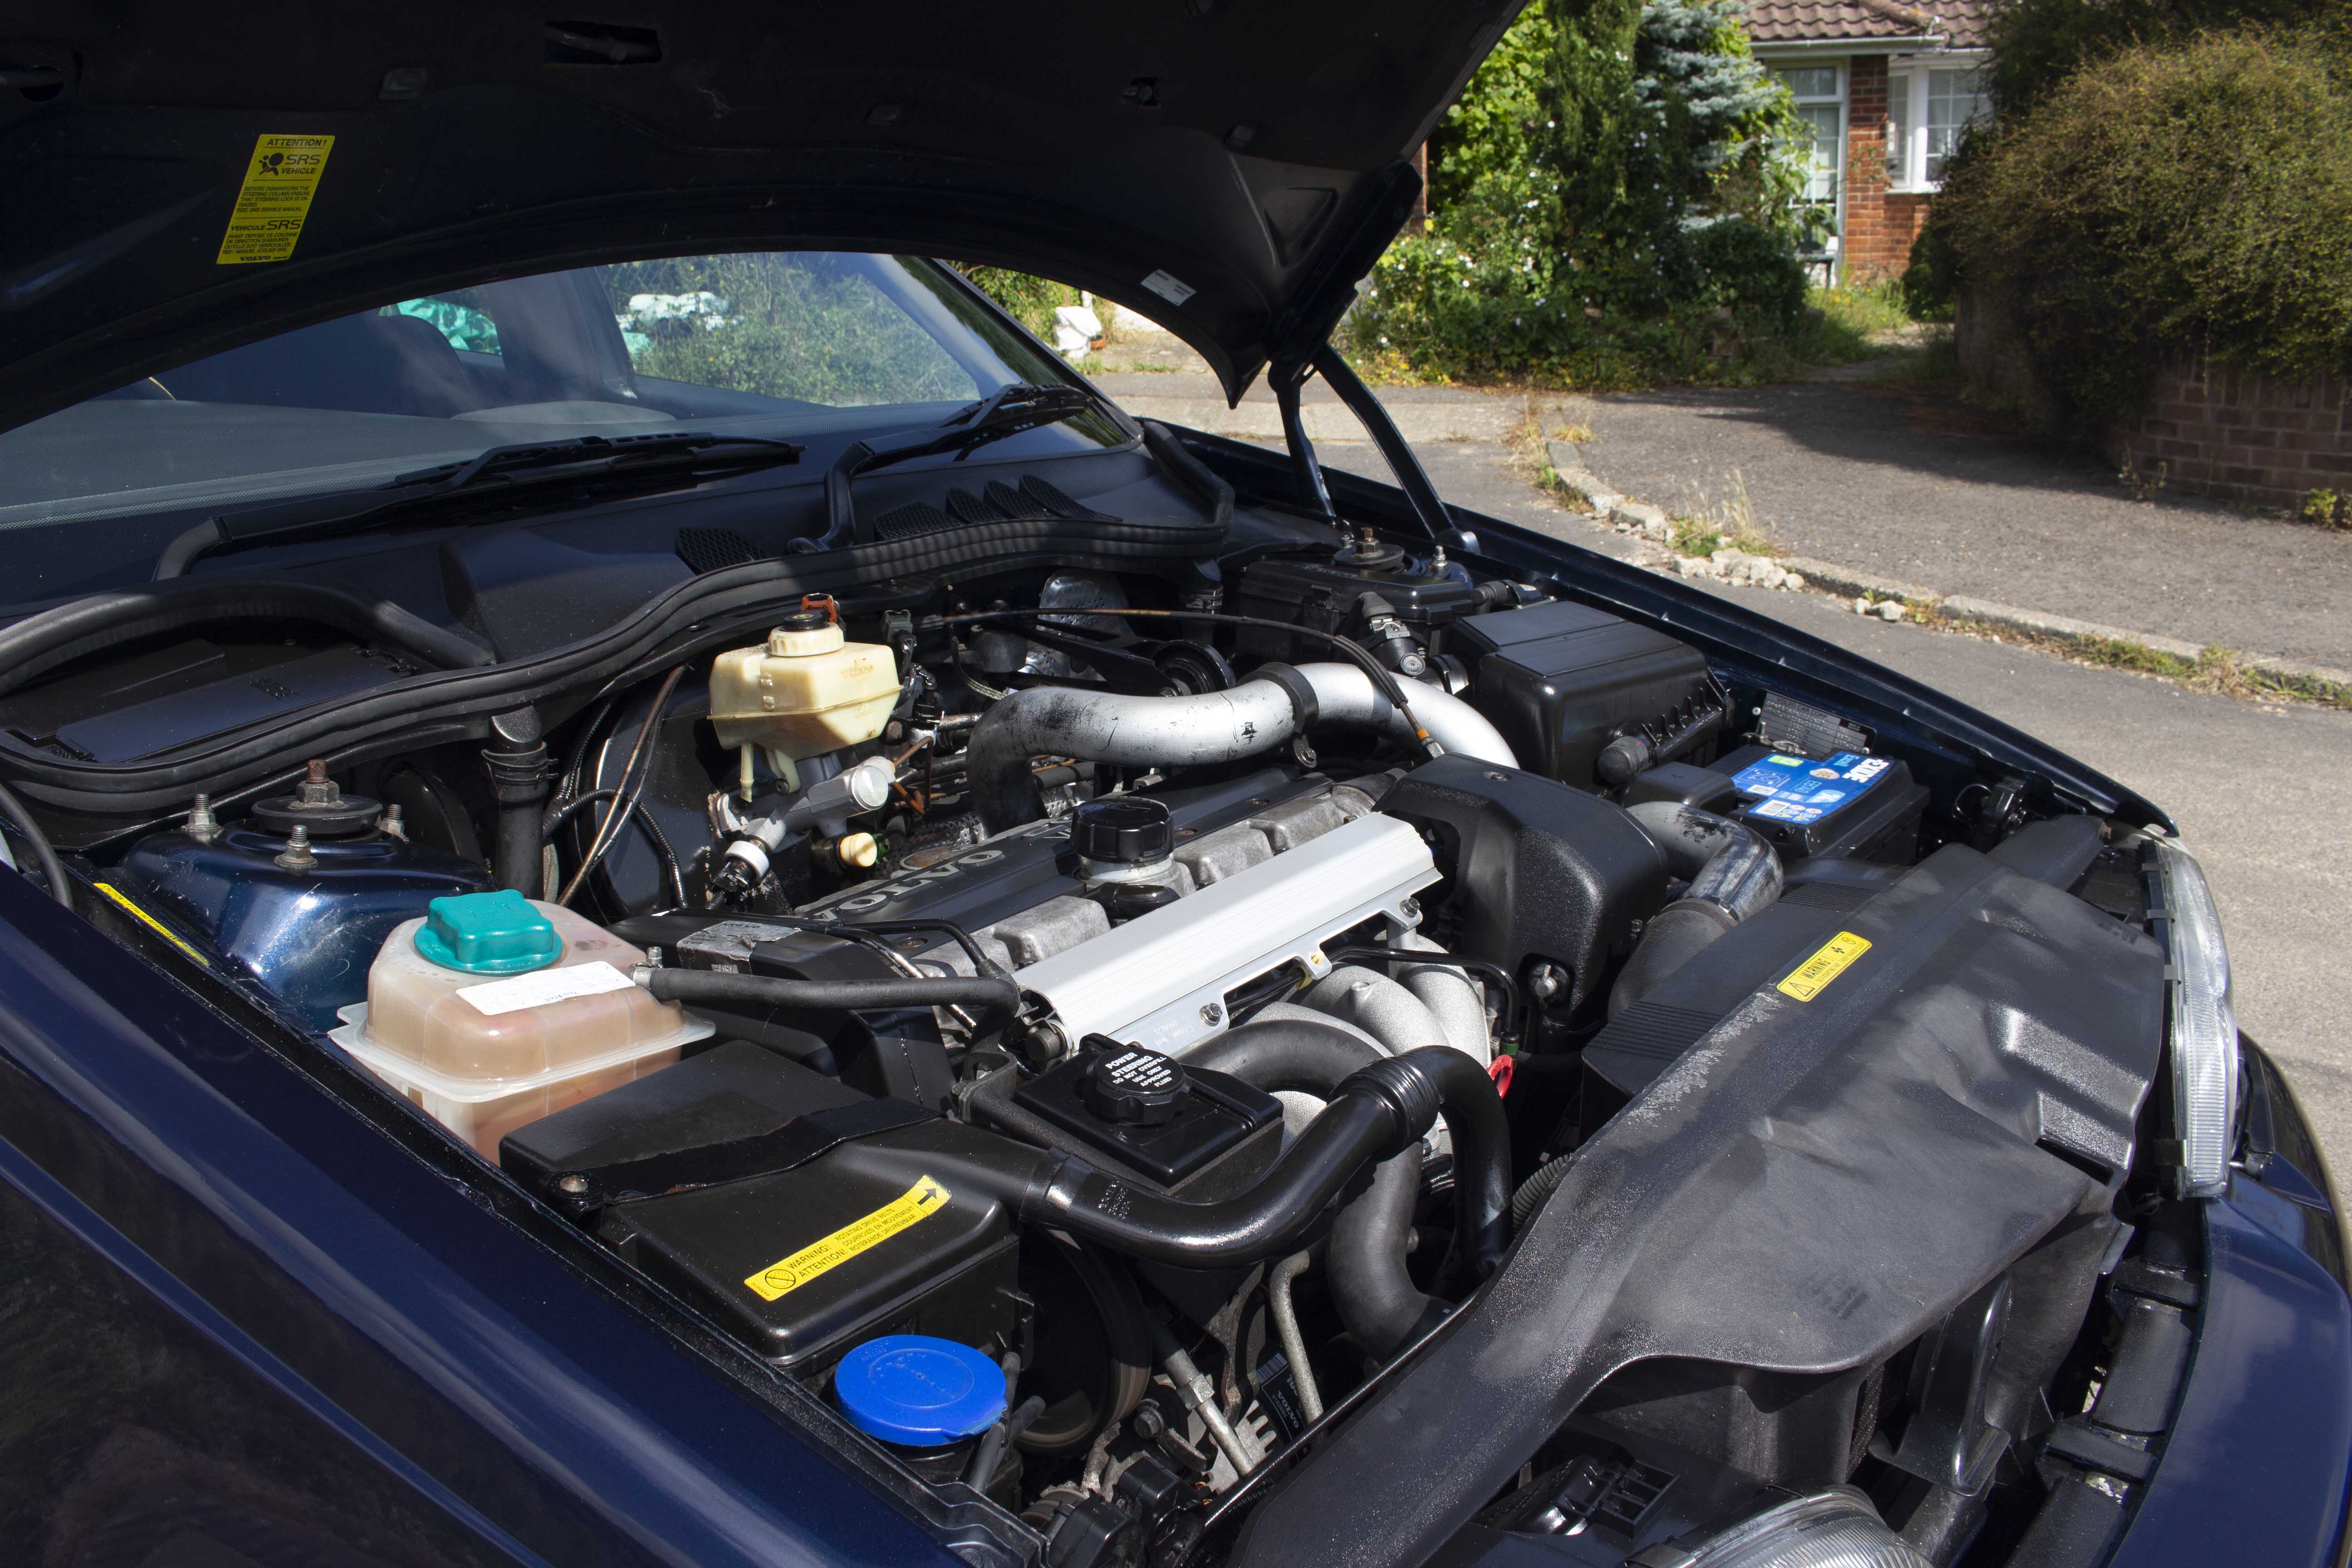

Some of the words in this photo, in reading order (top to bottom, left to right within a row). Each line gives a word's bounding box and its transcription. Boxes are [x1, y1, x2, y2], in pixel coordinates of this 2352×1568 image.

[285, 154, 322, 165] SRS
[266, 220, 302, 230] SRS
[1777, 697, 1797, 708] VOLVO
[1842, 758, 1890, 784] EXIDE
[103, 885, 123, 900] CAUTION
[814, 850, 1003, 922] VOLVO
[1800, 958, 1831, 980] WARNING
[544, 991, 577, 1002] VOLVO
[1105, 1052, 1138, 1069] POWER
[1111, 1055, 1153, 1077] STEERING
[1123, 1070, 1137, 1079] NOT
[1138, 1056, 1166, 1072] OVERFILL
[1132, 1074, 1147, 1083] USE
[1147, 1065, 1162, 1075] ONLY
[1140, 1069, 1171, 1087] APPROVED
[1154, 1077, 1172, 1087] FLUID
[835, 1225, 862, 1241] ROTATING
[862, 1217, 878, 1227] DRIVE
[877, 1208, 895, 1219] BELTS
[842, 1228, 875, 1246] COURROIES
[882, 1206, 915, 1225] MOUVEMENT
[849, 1233, 883, 1252] ROTERANDE
[787, 1245, 832, 1269] WARNING!
[799, 1249, 848, 1278] ATTENTION!
[1278, 1390, 1298, 1429] VOLVO
